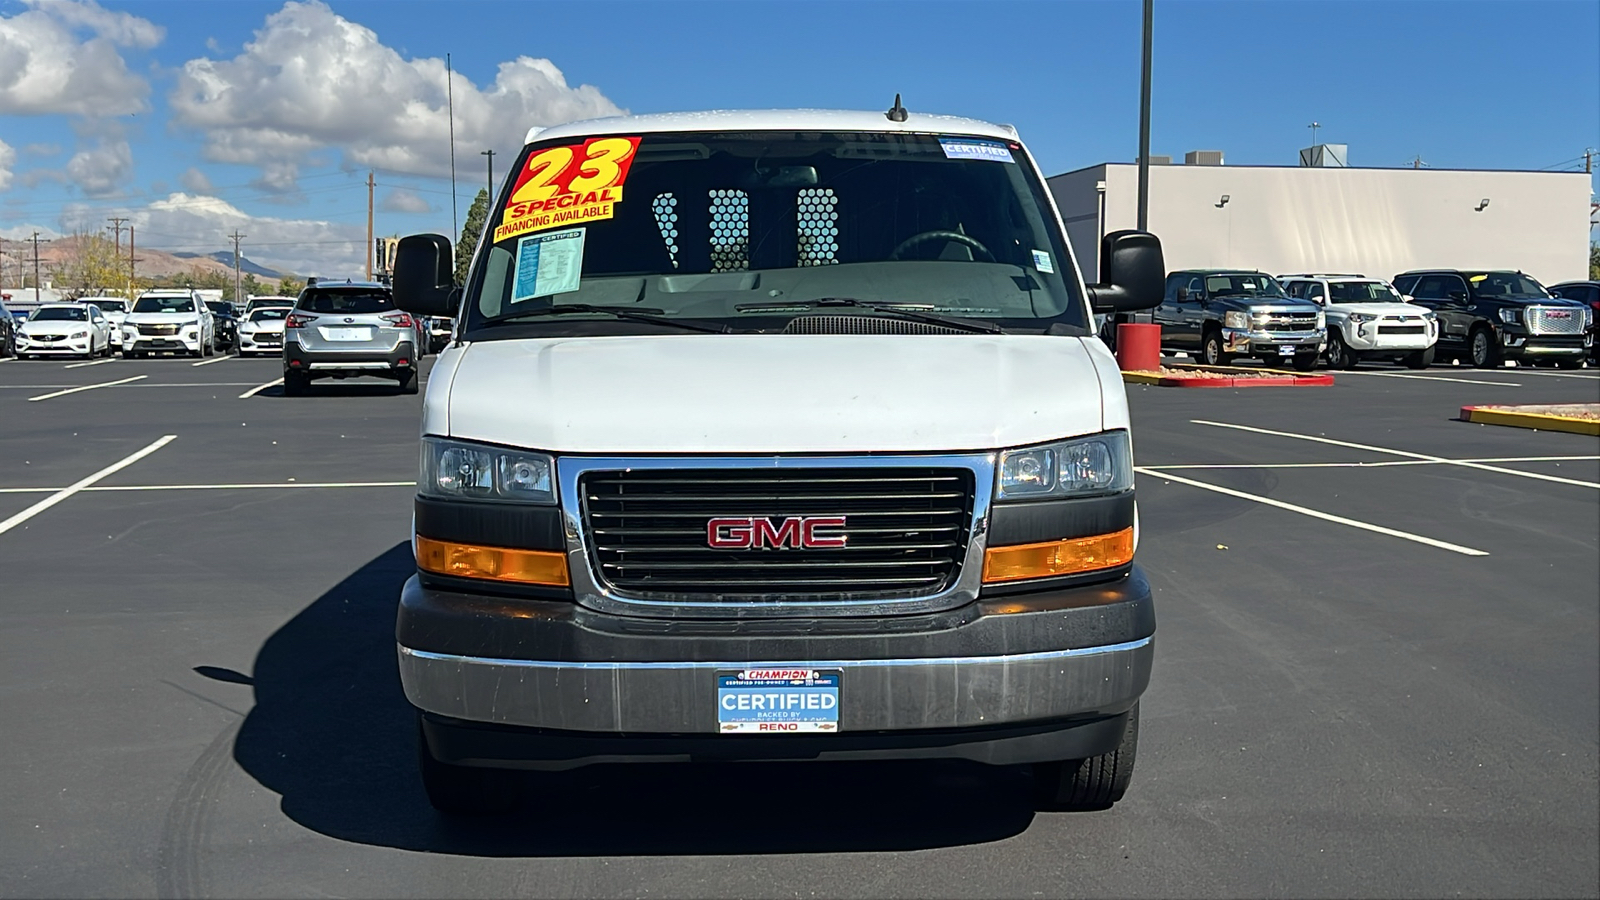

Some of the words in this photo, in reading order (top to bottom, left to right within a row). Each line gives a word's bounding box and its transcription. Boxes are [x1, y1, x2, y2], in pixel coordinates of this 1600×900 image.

[946, 145, 1008, 157] CERTIFIED
[511, 138, 634, 205] 23
[511, 189, 615, 219] SPECIAL
[496, 214, 550, 239] FINANCING
[552, 205, 610, 224] AVAILABLE
[541, 231, 580, 242] CERTIFIED
[707, 516, 848, 549] GMC
[749, 670, 808, 679] CHAMPION
[721, 693, 837, 711] CERTIFIED
[759, 723, 798, 731] RENO
